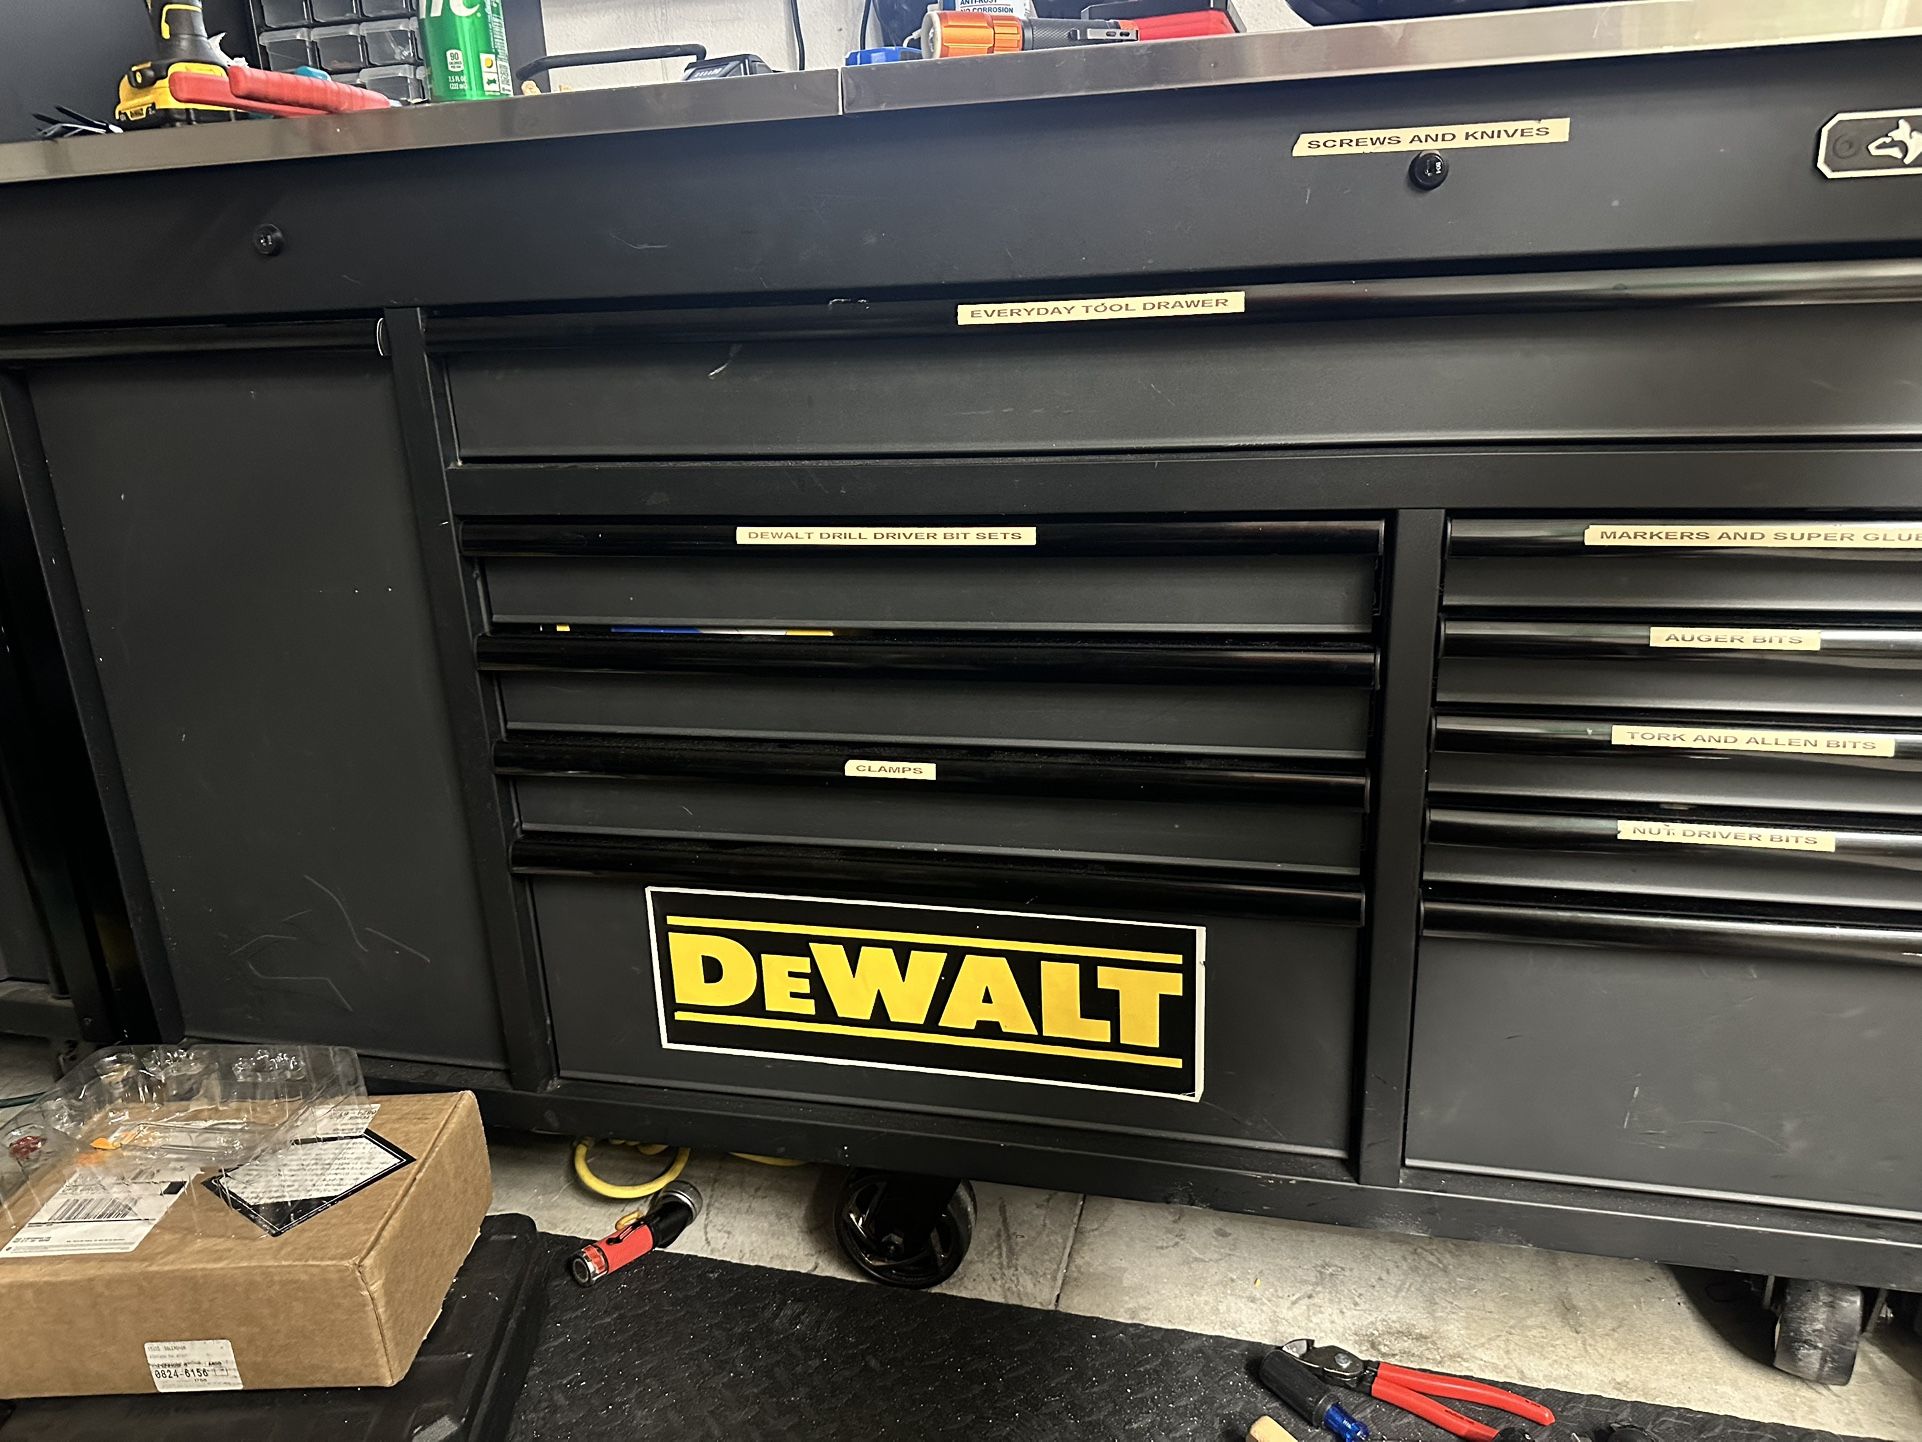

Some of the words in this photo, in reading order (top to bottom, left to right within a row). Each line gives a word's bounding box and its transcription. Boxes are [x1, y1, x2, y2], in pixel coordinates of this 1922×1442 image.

[1307, 135, 1402, 149] SCREWS
[1409, 132, 1457, 145] AND
[1464, 126, 1550, 141] KNIVES
[970, 305, 1076, 318] EVERYDAY
[1081, 302, 1137, 314] TOOL
[1142, 298, 1230, 311] DRAWER
[748, 531, 815, 540] DEWALT
[819, 532, 868, 540] DRILL
[873, 532, 938, 540] DRIVER
[943, 532, 971, 540] BIT
[976, 532, 1022, 540] SETS
[1600, 530, 1710, 541] MARKERS
[1717, 531, 1766, 541] AND
[1773, 531, 1855, 542] SUPER
[1665, 633, 1745, 643] AUGER
[1752, 635, 1803, 644] BITS
[1626, 731, 1686, 742] TORK
[1692, 734, 1739, 744] AND
[1745, 736, 1818, 747] ALLEN
[1826, 739, 1877, 750] BITS
[856, 765, 923, 774] CLAMPS
[1632, 826, 1674, 836] NUT
[1681, 829, 1762, 841] DRIVER
[1769, 834, 1818, 845] BITS
[667, 931, 1184, 1049] DEWALT
